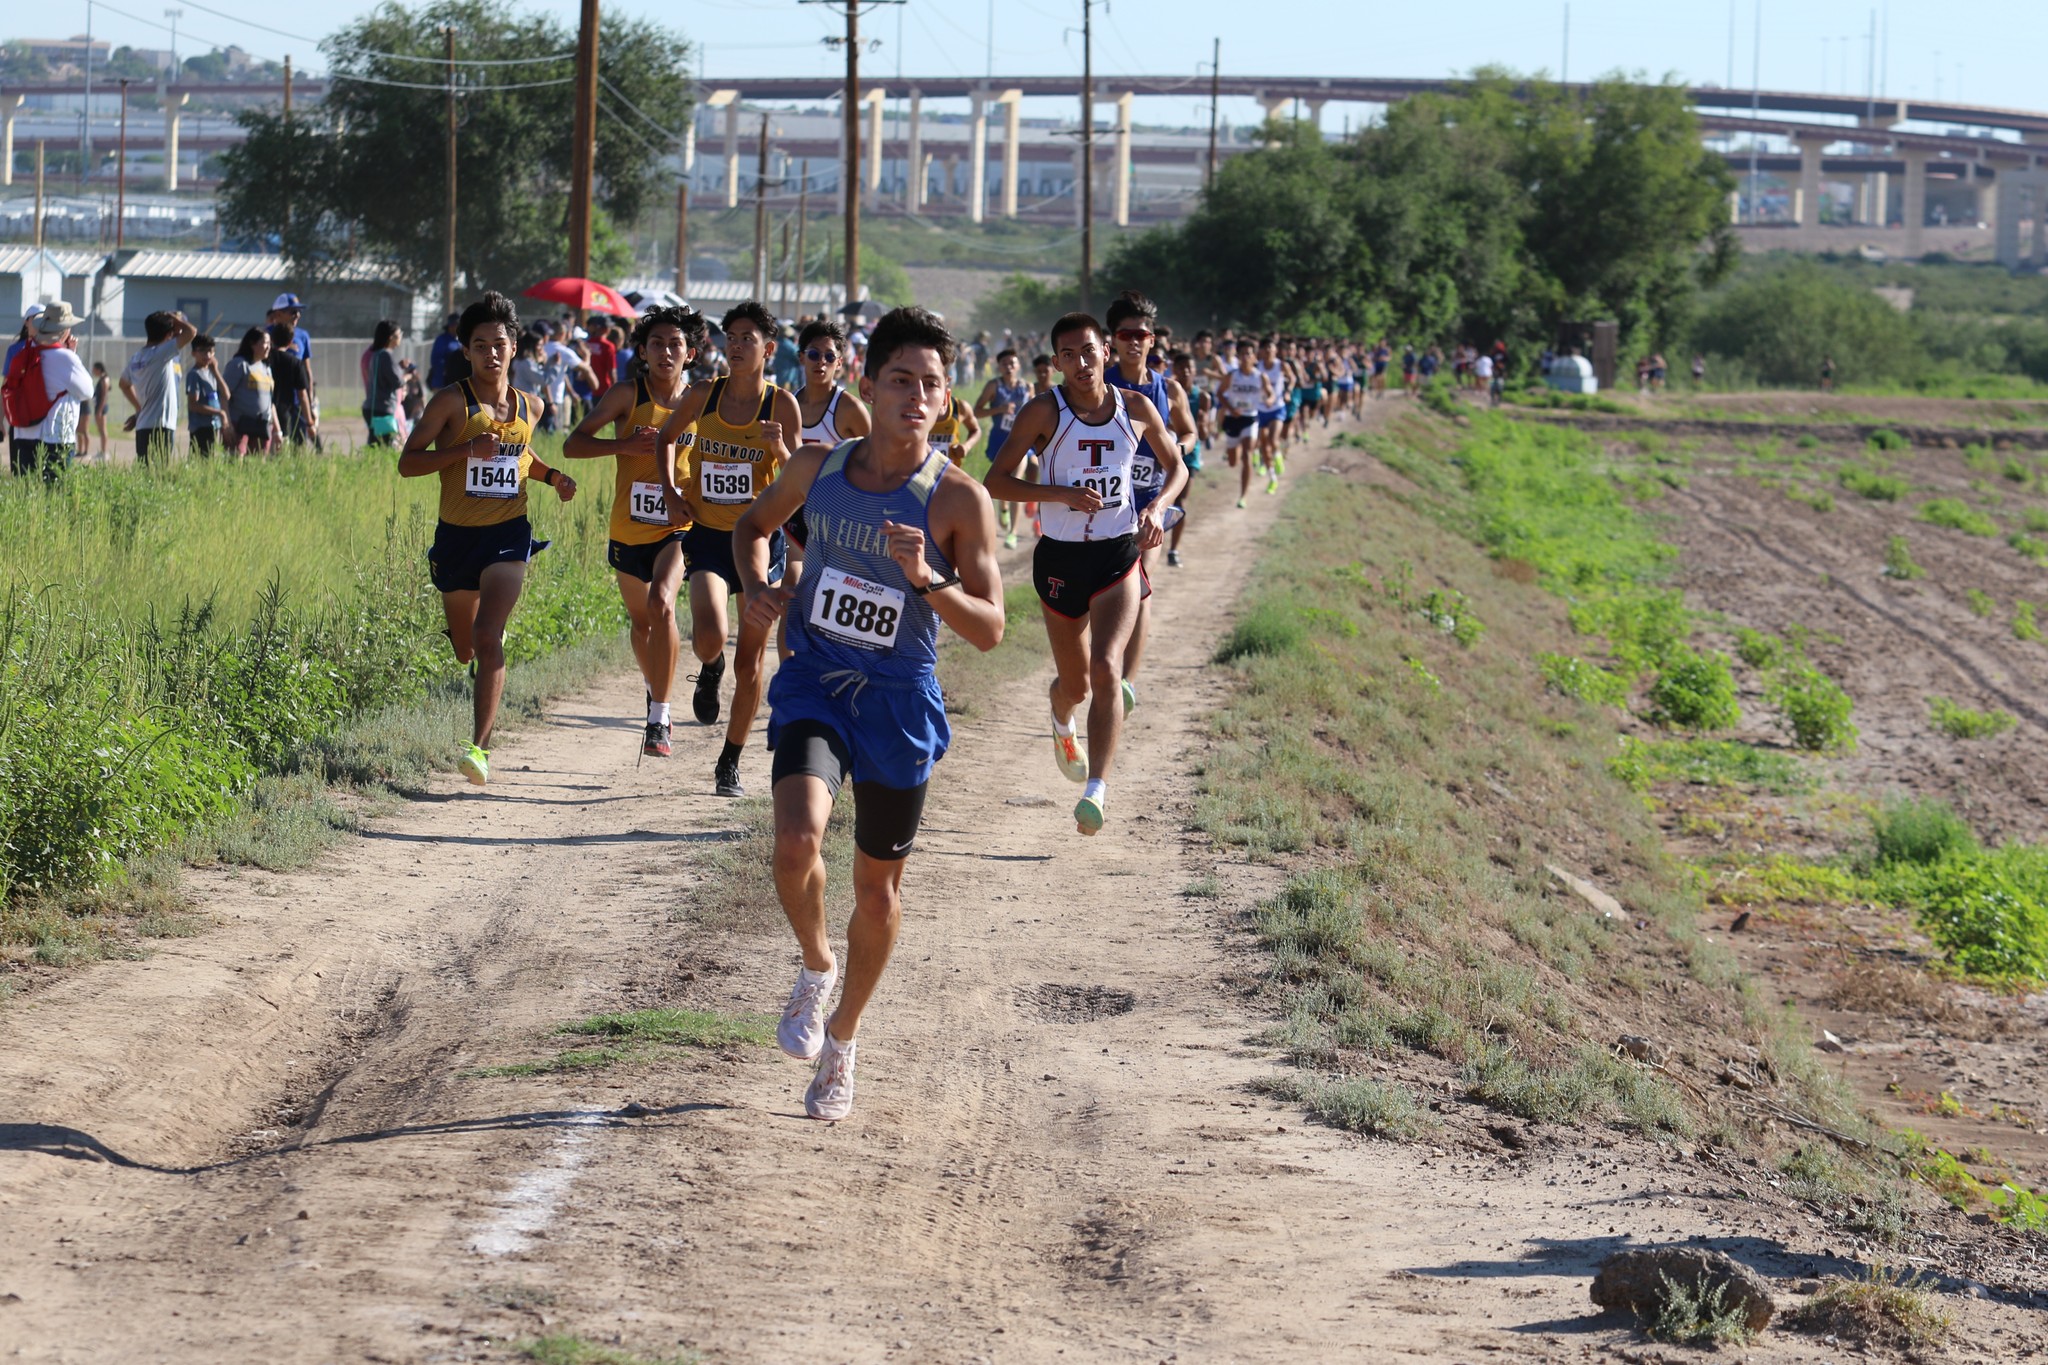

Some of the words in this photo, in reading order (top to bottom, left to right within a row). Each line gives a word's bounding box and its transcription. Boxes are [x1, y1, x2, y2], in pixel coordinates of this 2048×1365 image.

[1078, 439, 1115, 466] T
[470, 466, 517, 488] 1544
[713, 463, 739, 471] MileSplit
[1082, 466, 1109, 475] MileSplit
[1131, 464, 1152, 483] 52
[644, 483, 663, 492] MileSp
[703, 473, 751, 494] 1539
[633, 493, 668, 516] 154
[842, 575, 885, 597] MileSplit
[1047, 576, 1065, 599] T
[821, 588, 898, 638] 1888
